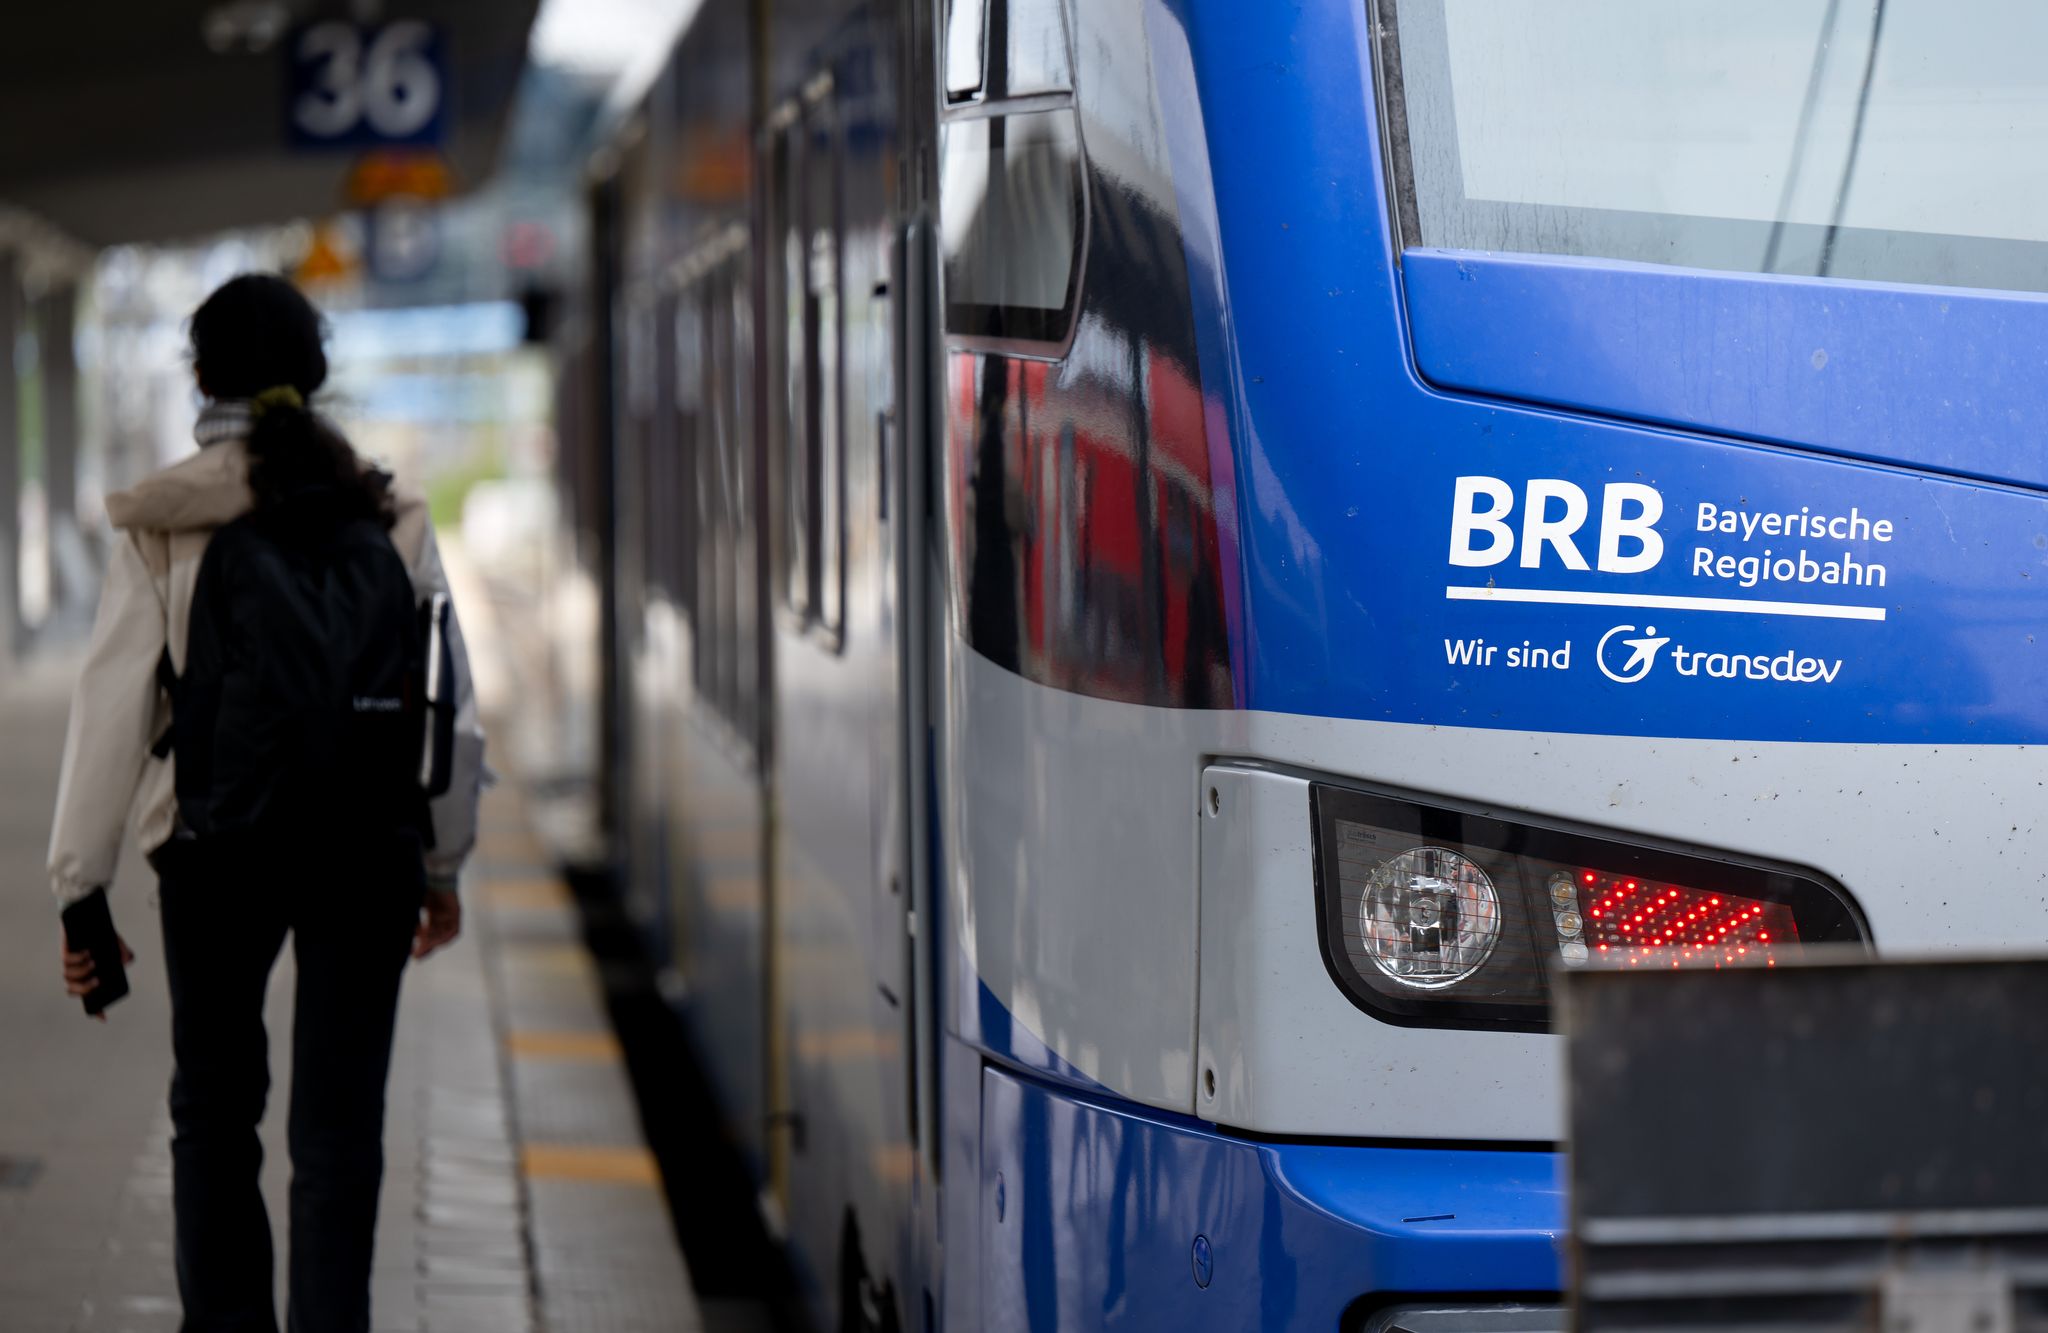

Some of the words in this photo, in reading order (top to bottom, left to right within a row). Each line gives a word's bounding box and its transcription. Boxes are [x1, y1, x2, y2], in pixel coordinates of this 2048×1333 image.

[296, 19, 441, 137] 36
[1449, 476, 1664, 574] BRB
[1696, 502, 1894, 543] Bayerische
[1692, 547, 1887, 588] Regiobahn
[1444, 639, 1498, 666] Wir
[1506, 640, 1571, 670] sind
[1671, 645, 1843, 683] transdev
